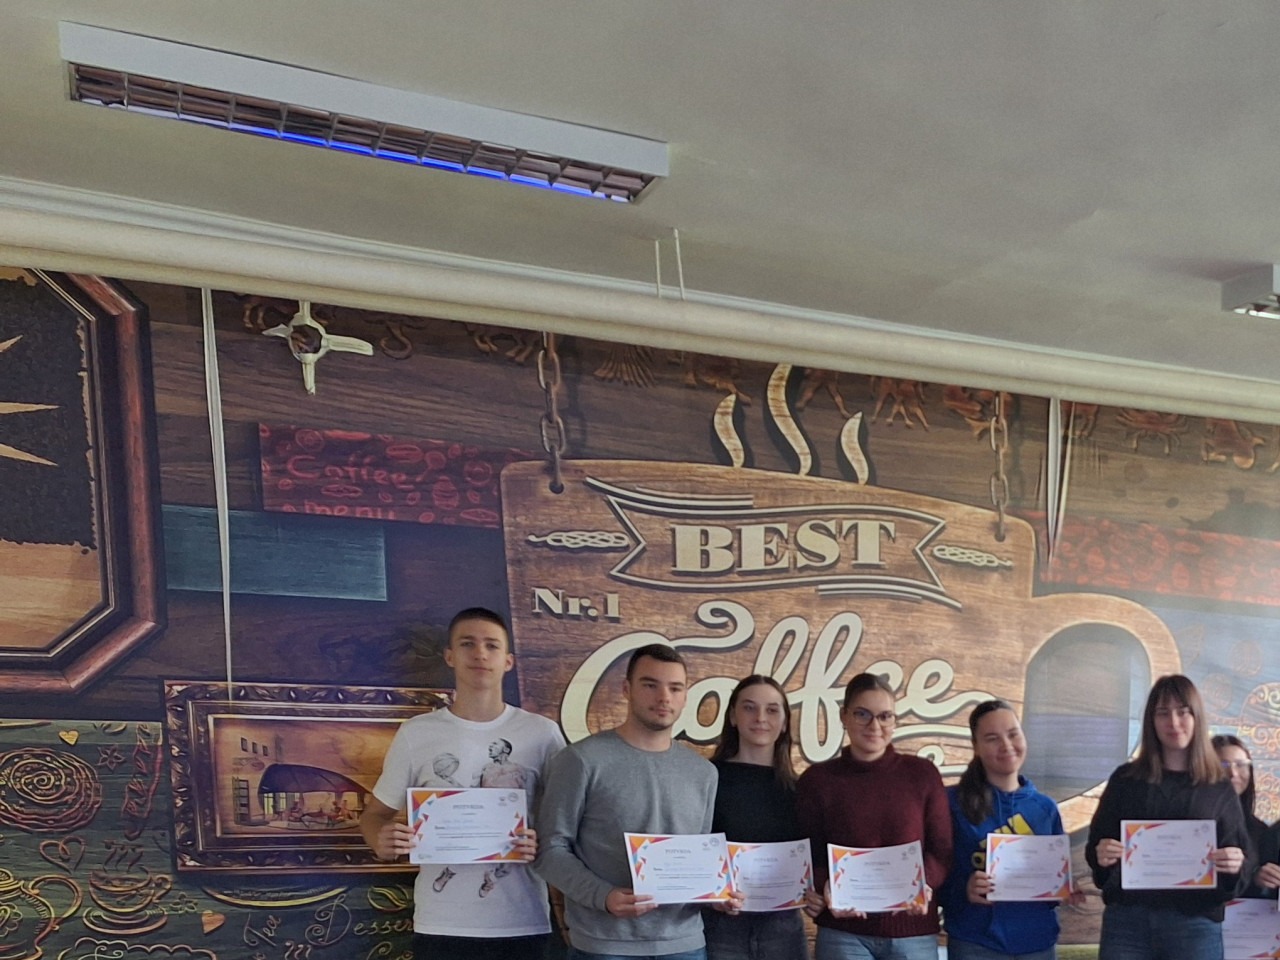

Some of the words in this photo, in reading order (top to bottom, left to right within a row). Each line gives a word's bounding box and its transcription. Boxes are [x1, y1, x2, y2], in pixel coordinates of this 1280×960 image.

[669, 519, 896, 573] BEST
[243, 911, 283, 947] Tea
[305, 894, 414, 946] Desser
